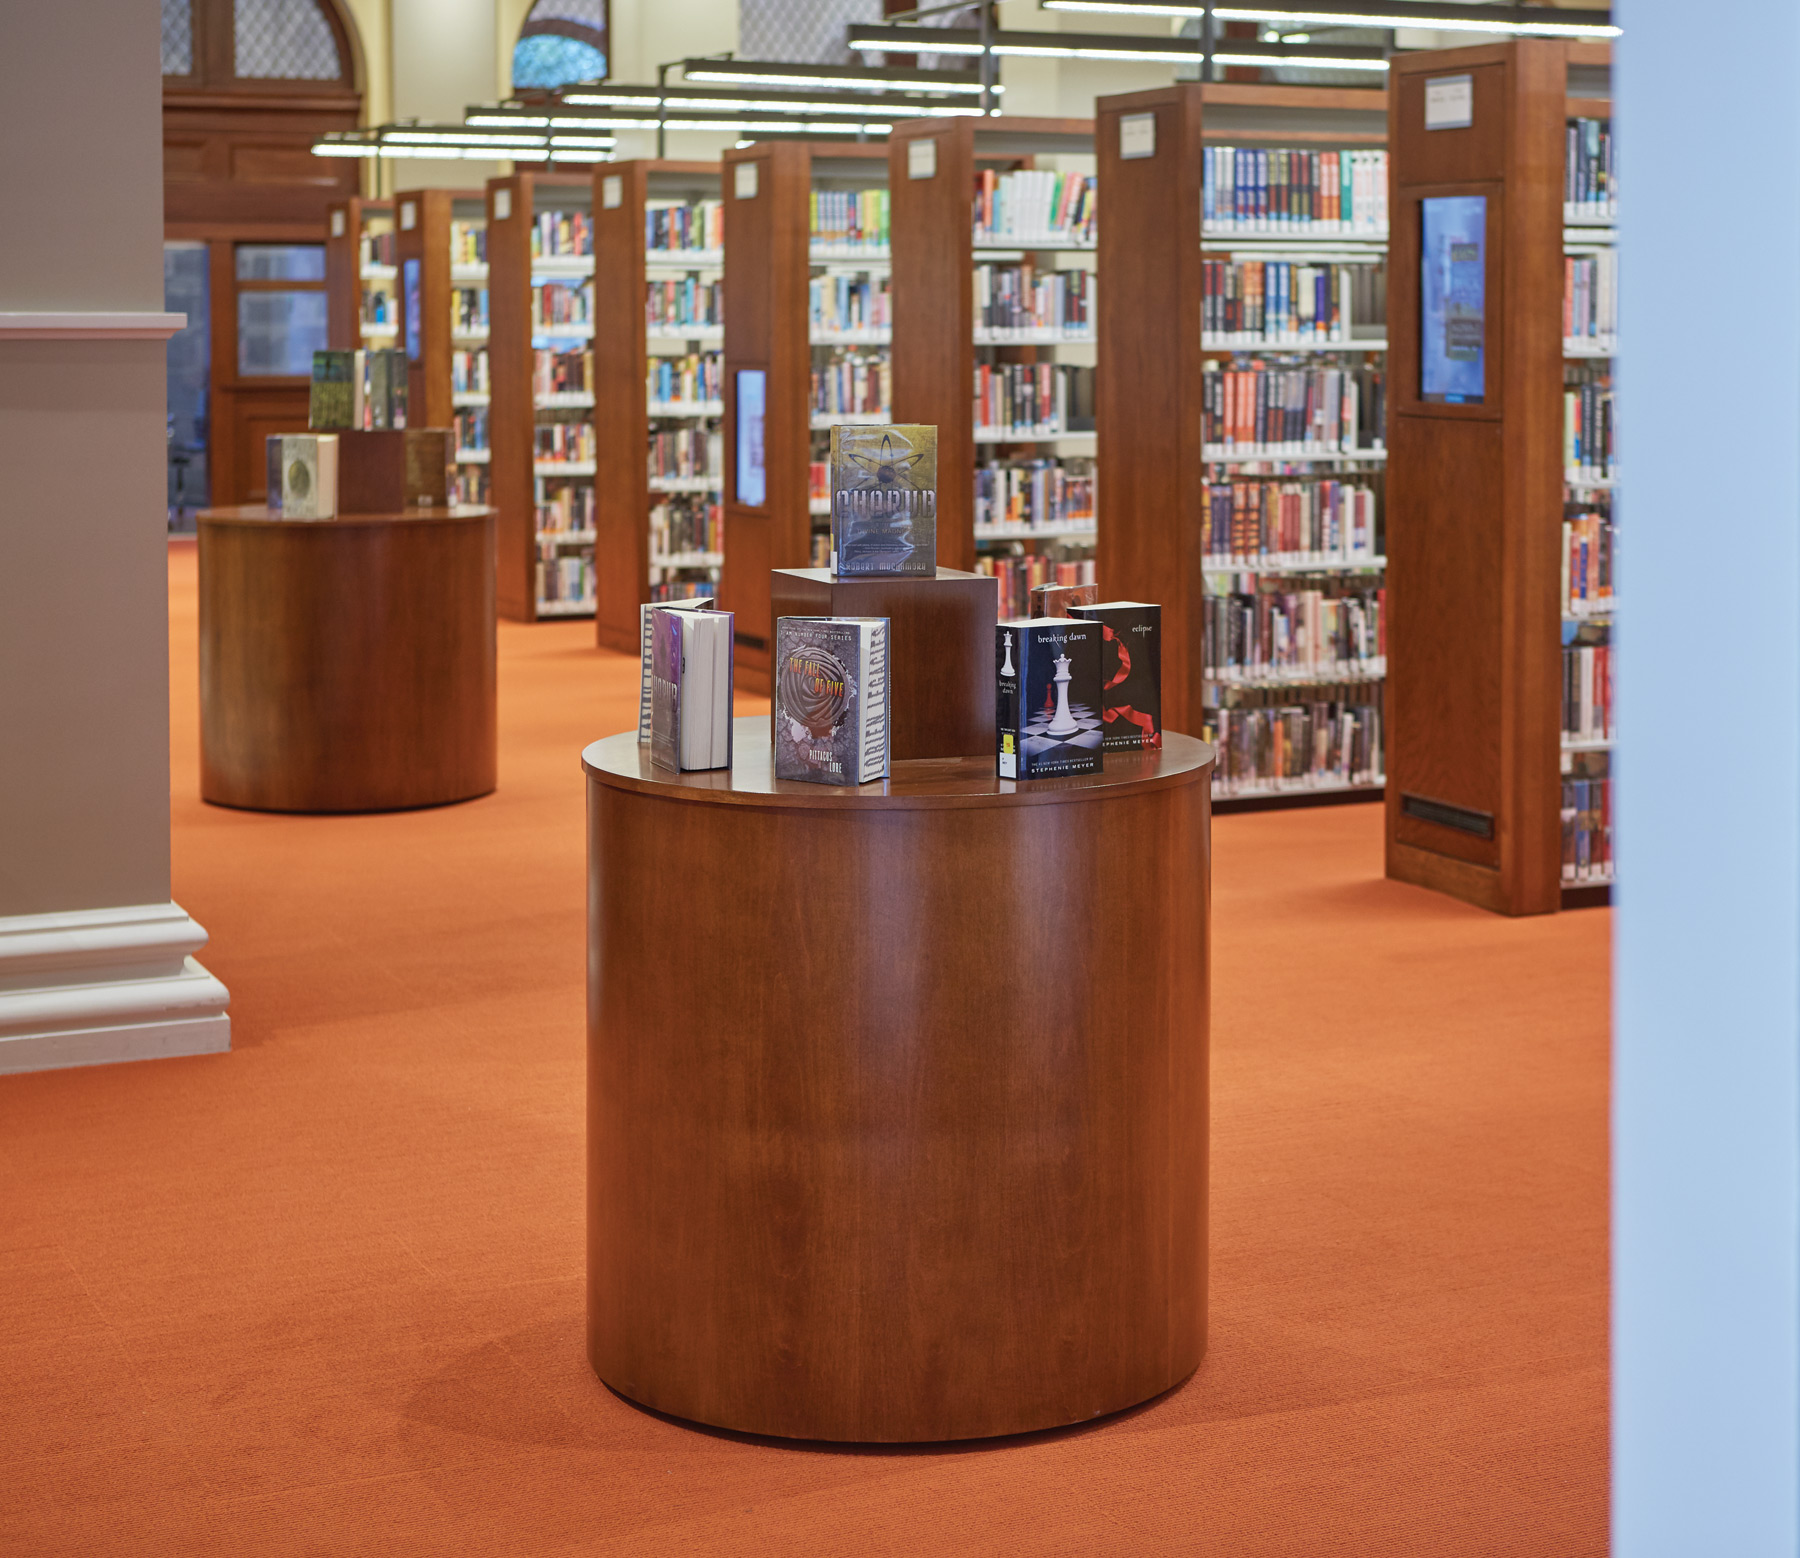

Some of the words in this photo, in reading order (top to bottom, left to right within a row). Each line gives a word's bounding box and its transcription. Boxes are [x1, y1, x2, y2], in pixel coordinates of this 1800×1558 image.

[836, 489, 936, 518] CHERUB
[1132, 624, 1152, 638] eclipse
[1037, 632, 1068, 648] breaking
[1069, 632, 1087, 641] dawn
[789, 657, 803, 673] THE
[804, 660, 820, 678] FALL
[867, 625, 885, 710] LEGACIES
[814, 678, 824, 693] OF
[825, 679, 844, 697] FIVE
[809, 750, 833, 762] PITTACUS
[829, 762, 842, 774] LORE
[1031, 764, 1069, 773] STEPHENIE
